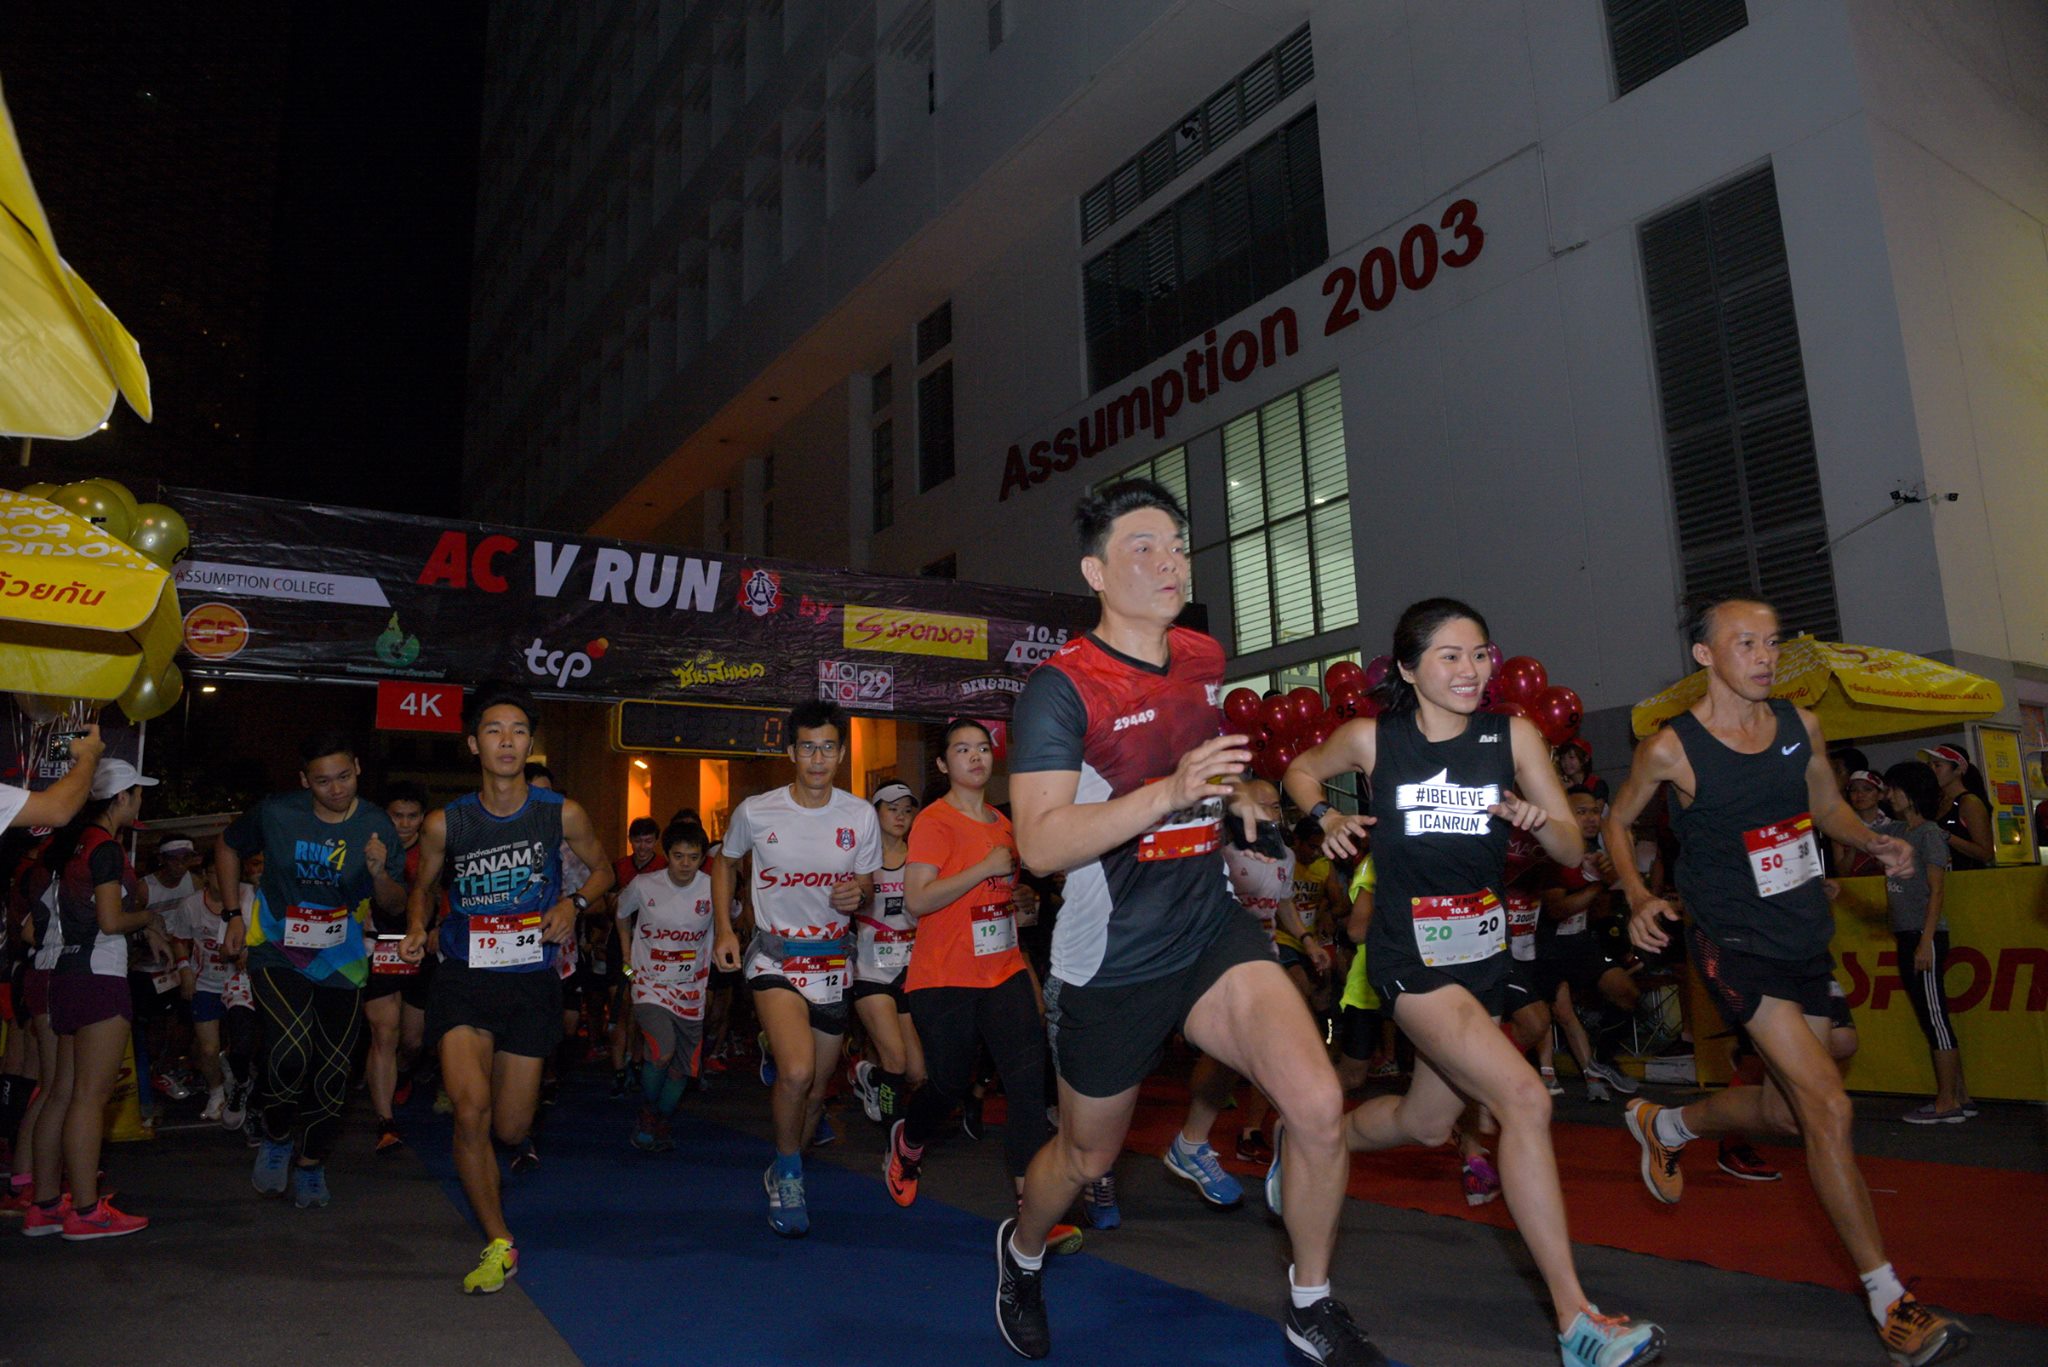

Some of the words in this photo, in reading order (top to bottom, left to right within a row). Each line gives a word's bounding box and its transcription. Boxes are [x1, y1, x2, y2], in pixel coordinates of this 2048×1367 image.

[1000, 306, 1300, 501] Assumption
[1322, 199, 1484, 337] 2003
[416, 531, 520, 593] AC
[534, 541, 581, 598] V
[589, 547, 722, 613] RUN
[175, 570, 270, 590] ASSUMPTION
[273, 577, 336, 596] COLLEGE
[886, 621, 977, 645] SPONSOR
[1026, 625, 1068, 644] 10.5
[1016, 647, 1022, 658] 1
[524, 638, 592, 688] tcp
[859, 671, 892, 698] 29
[400, 692, 443, 718] 4K
[1113, 709, 1156, 731] 29449
[763, 717, 783, 747] 0
[1416, 788, 1485, 807] #IBELIEVE
[1419, 814, 1480, 831] ICANRUN
[455, 848, 532, 878] SANAM
[1761, 854, 1783, 872] 50
[454, 866, 531, 896] THEP
[462, 892, 510, 907] RUNNER
[1441, 897, 1453, 907] AC
[292, 924, 309, 933] 50
[326, 924, 342, 934] 42
[981, 925, 996, 937] 19
[1425, 926, 1453, 942] 20
[1478, 916, 1499, 936] 20
[479, 938, 497, 948] 19
[516, 934, 535, 946] 34
[879, 946, 893, 955] 20
[653, 964, 666, 972] 40
[679, 964, 691, 972] 70
[791, 977, 807, 988] 20
[826, 975, 838, 986] 12
